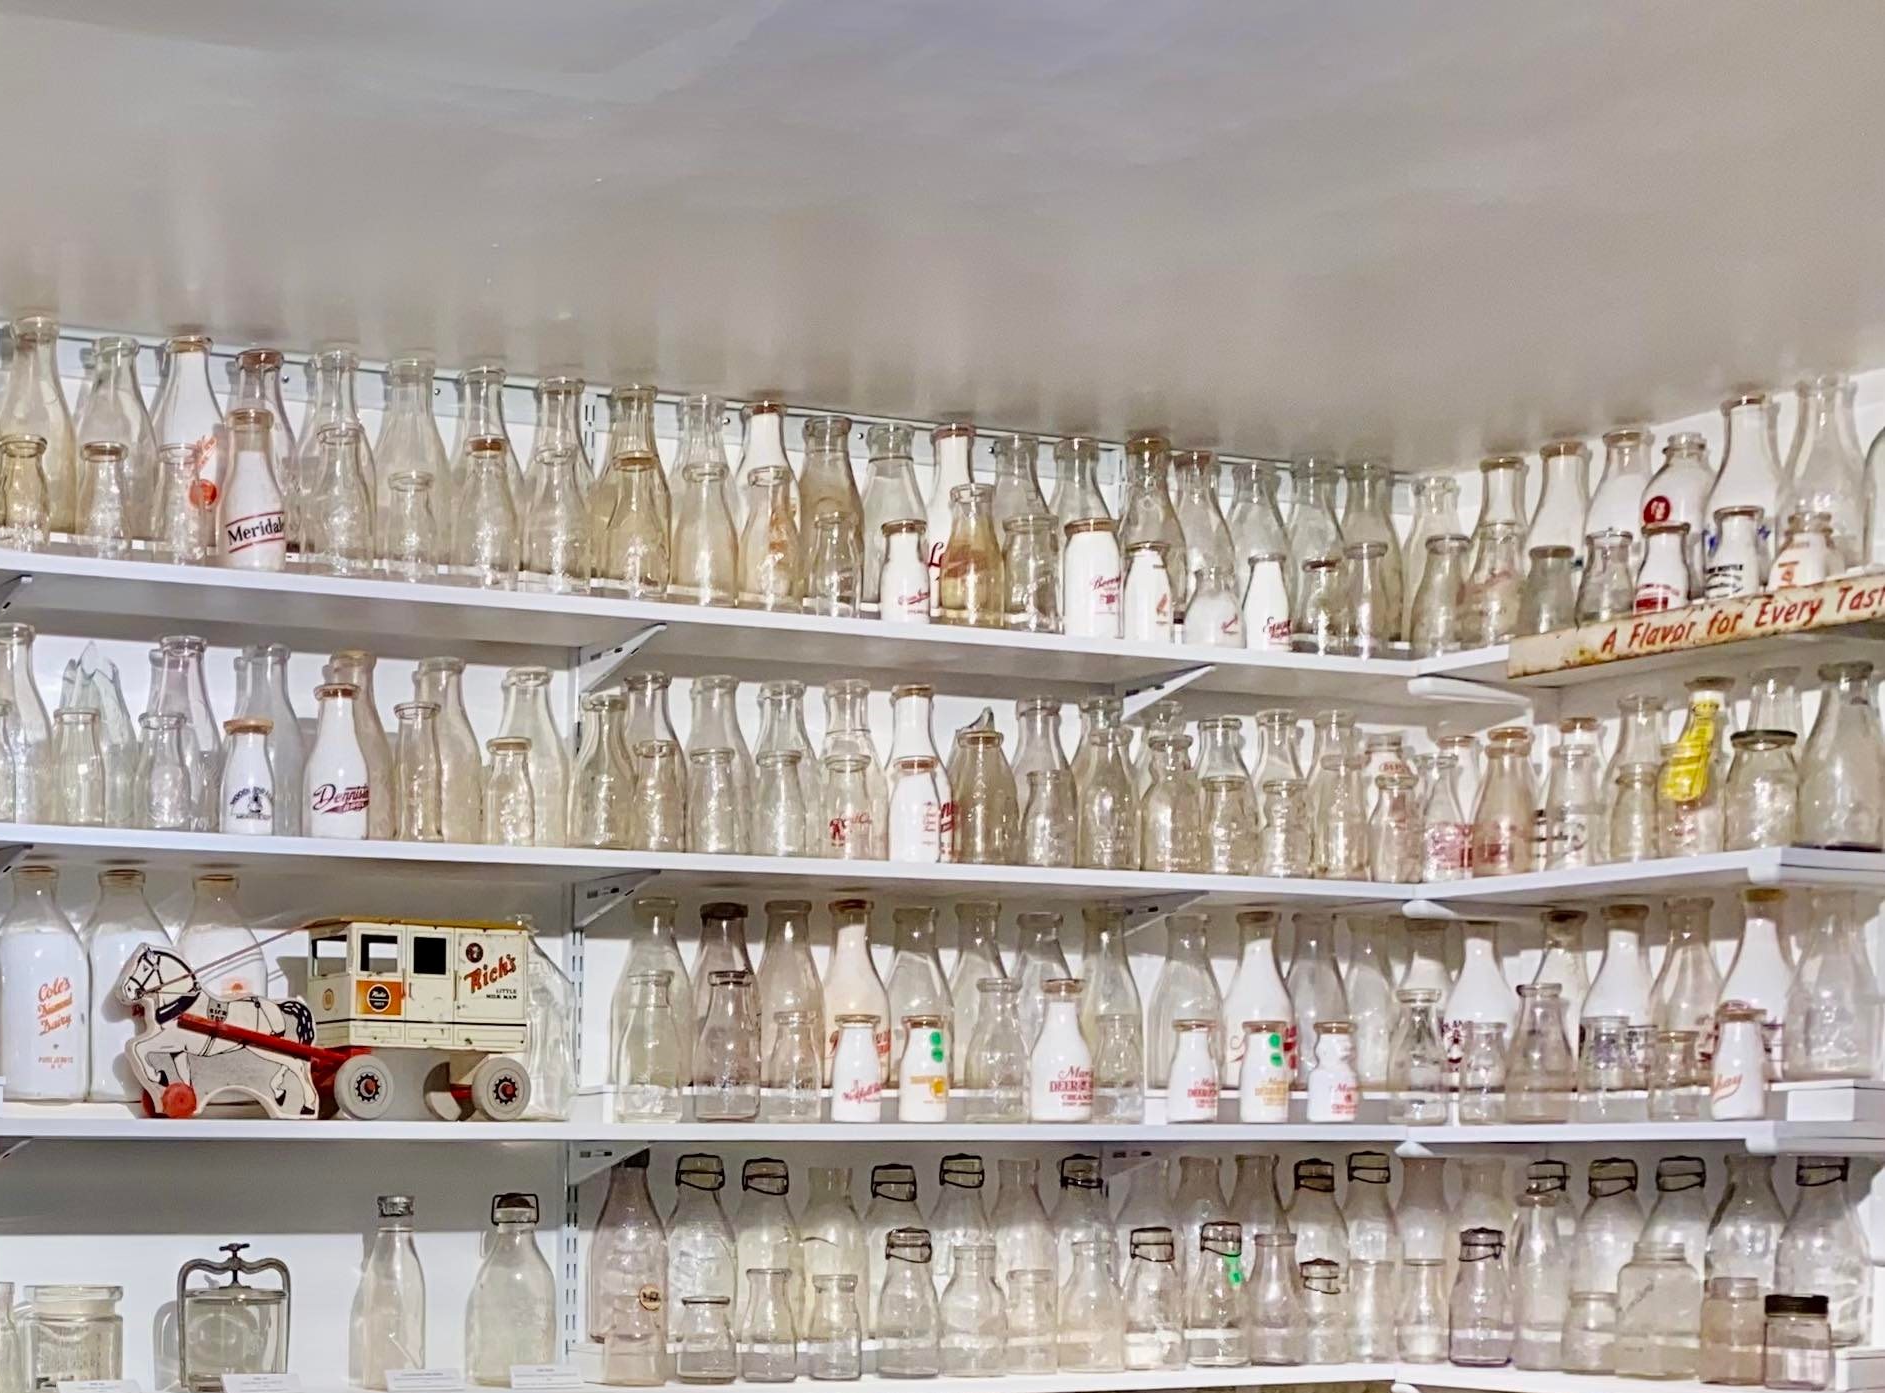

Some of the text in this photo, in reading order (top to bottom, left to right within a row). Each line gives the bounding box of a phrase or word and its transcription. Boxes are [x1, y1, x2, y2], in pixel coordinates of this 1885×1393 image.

[227, 518, 284, 546] Meridal
[1602, 627, 1618, 654] A
[1628, 622, 1697, 649] Flavor
[1707, 609, 1744, 637] for
[1755, 598, 1824, 628] Every
[463, 954, 517, 995] Rich's
